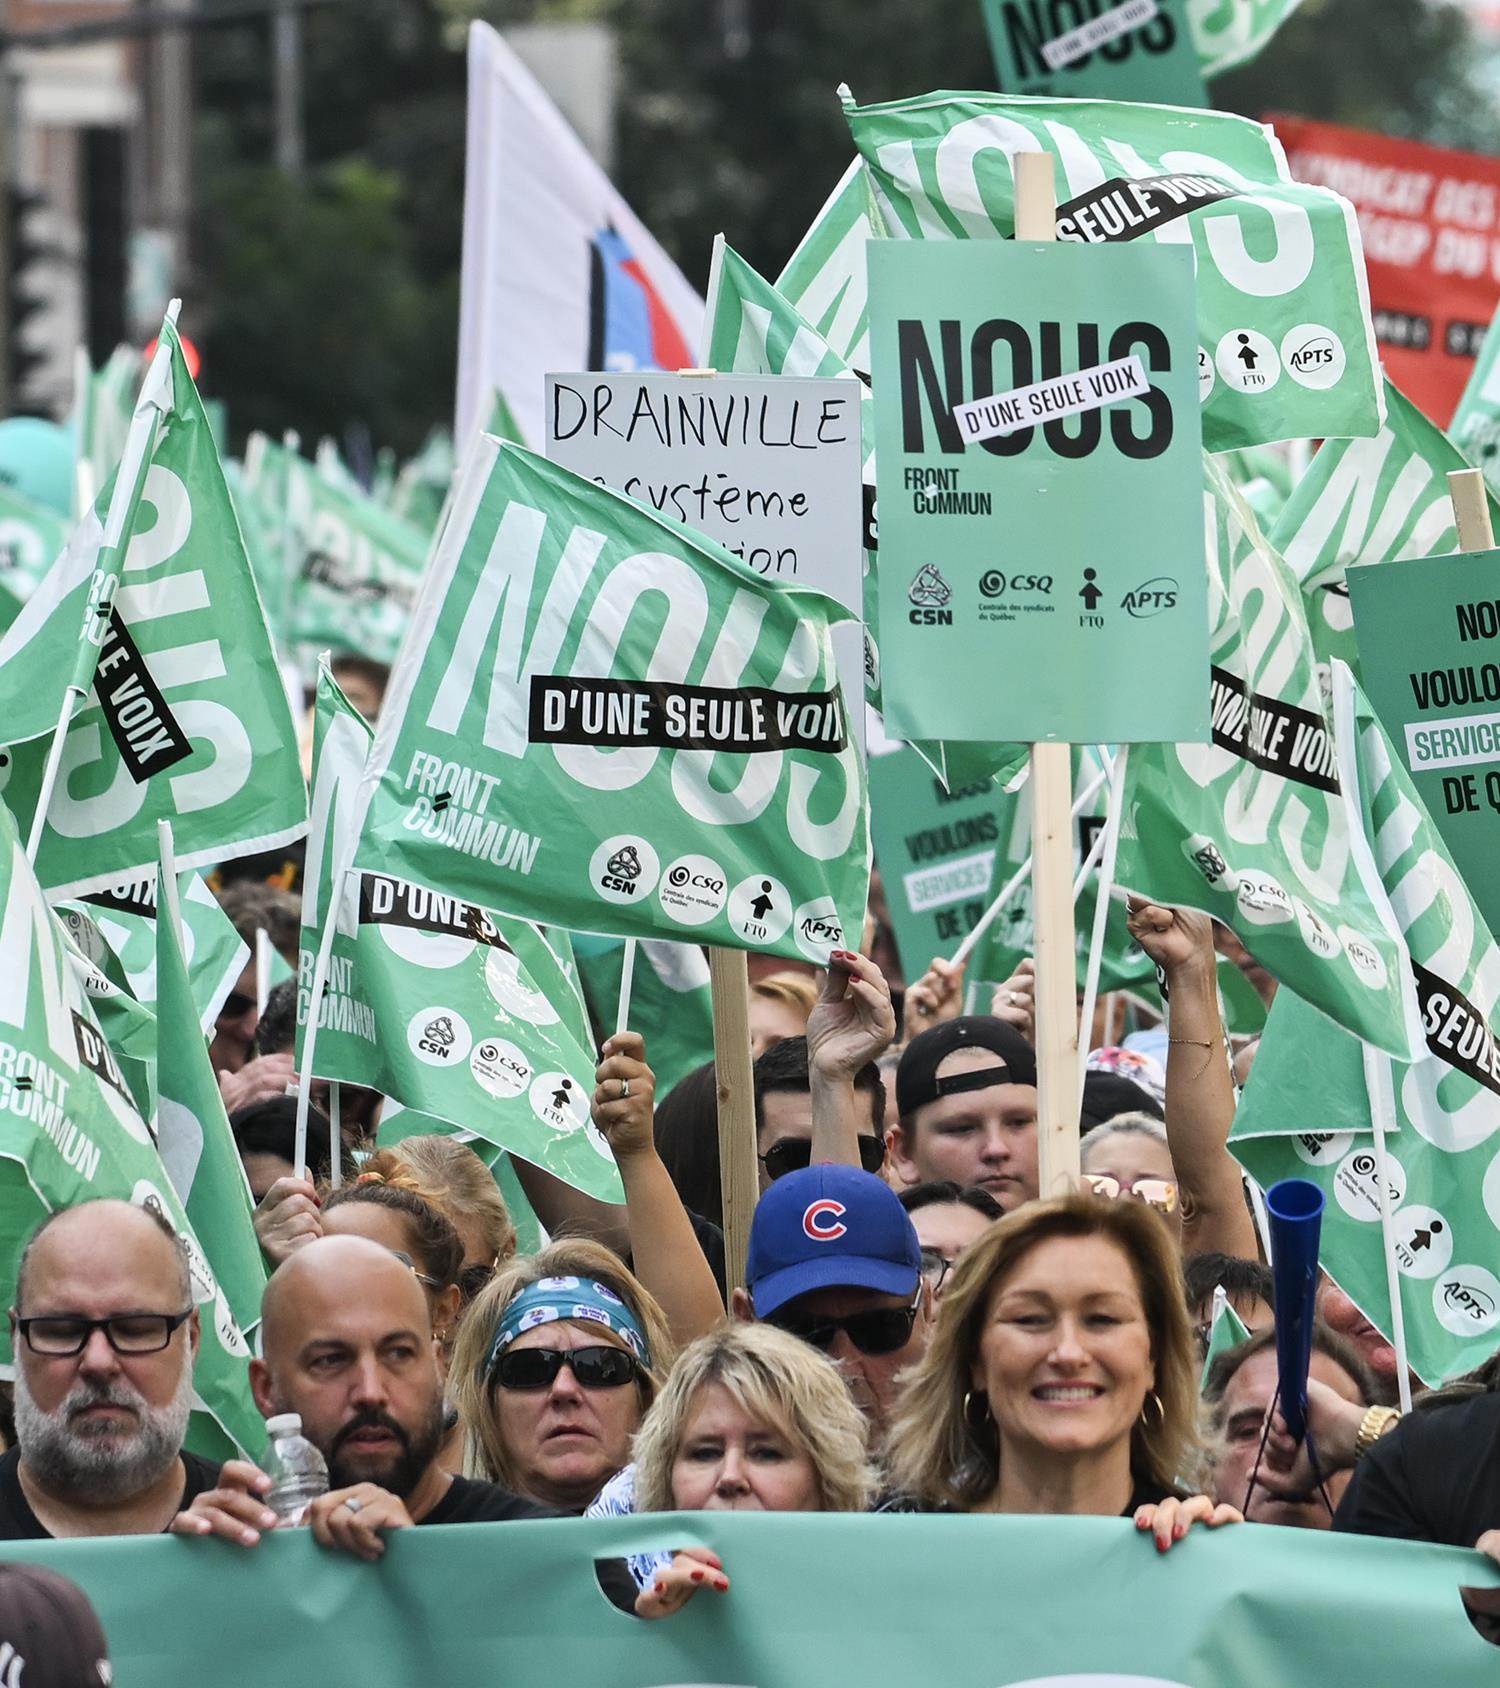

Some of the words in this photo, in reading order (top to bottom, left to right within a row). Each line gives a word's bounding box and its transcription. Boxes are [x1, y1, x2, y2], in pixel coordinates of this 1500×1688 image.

[1289, 348, 1334, 366] APTS
[897, 318, 1174, 460] NOUS
[1242, 374, 1266, 386] FTQ
[963, 397, 1025, 435] D'UNE
[1028, 380, 1083, 416] SEULE
[1090, 366, 1139, 400] VOIX
[553, 383, 848, 449] DRAINVILLE
[903, 467, 960, 491] FRONT
[913, 492, 992, 516] COMMUN
[1010, 575, 1053, 594] CSQ
[978, 603, 1008, 612] Centrale
[1009, 603, 1022, 612] des
[1023, 603, 1055, 614] syndicats
[1119, 591, 1177, 610] APTS
[908, 609, 953, 626] CSN
[1079, 615, 1104, 629] FTQ
[109, 672, 176, 766] VOIX
[544, 688, 650, 737] D'UNE
[665, 694, 766, 741] SEULE
[404, 751, 500, 818] FRONT
[1442, 775, 1482, 815] DE
[402, 795, 542, 877] COMMUN
[600, 875, 637, 896] CSN
[691, 874, 724, 895] CSQ
[372, 878, 469, 929] D'UNE
[743, 922, 768, 940] FTQ
[801, 918, 843, 942] APTS
[85, 976, 110, 993] FTQ
[418, 1039, 450, 1059] CSN
[500, 1056, 528, 1079] CSQ
[802, 1199, 848, 1242] C
[1443, 1281, 1488, 1320] APTS
